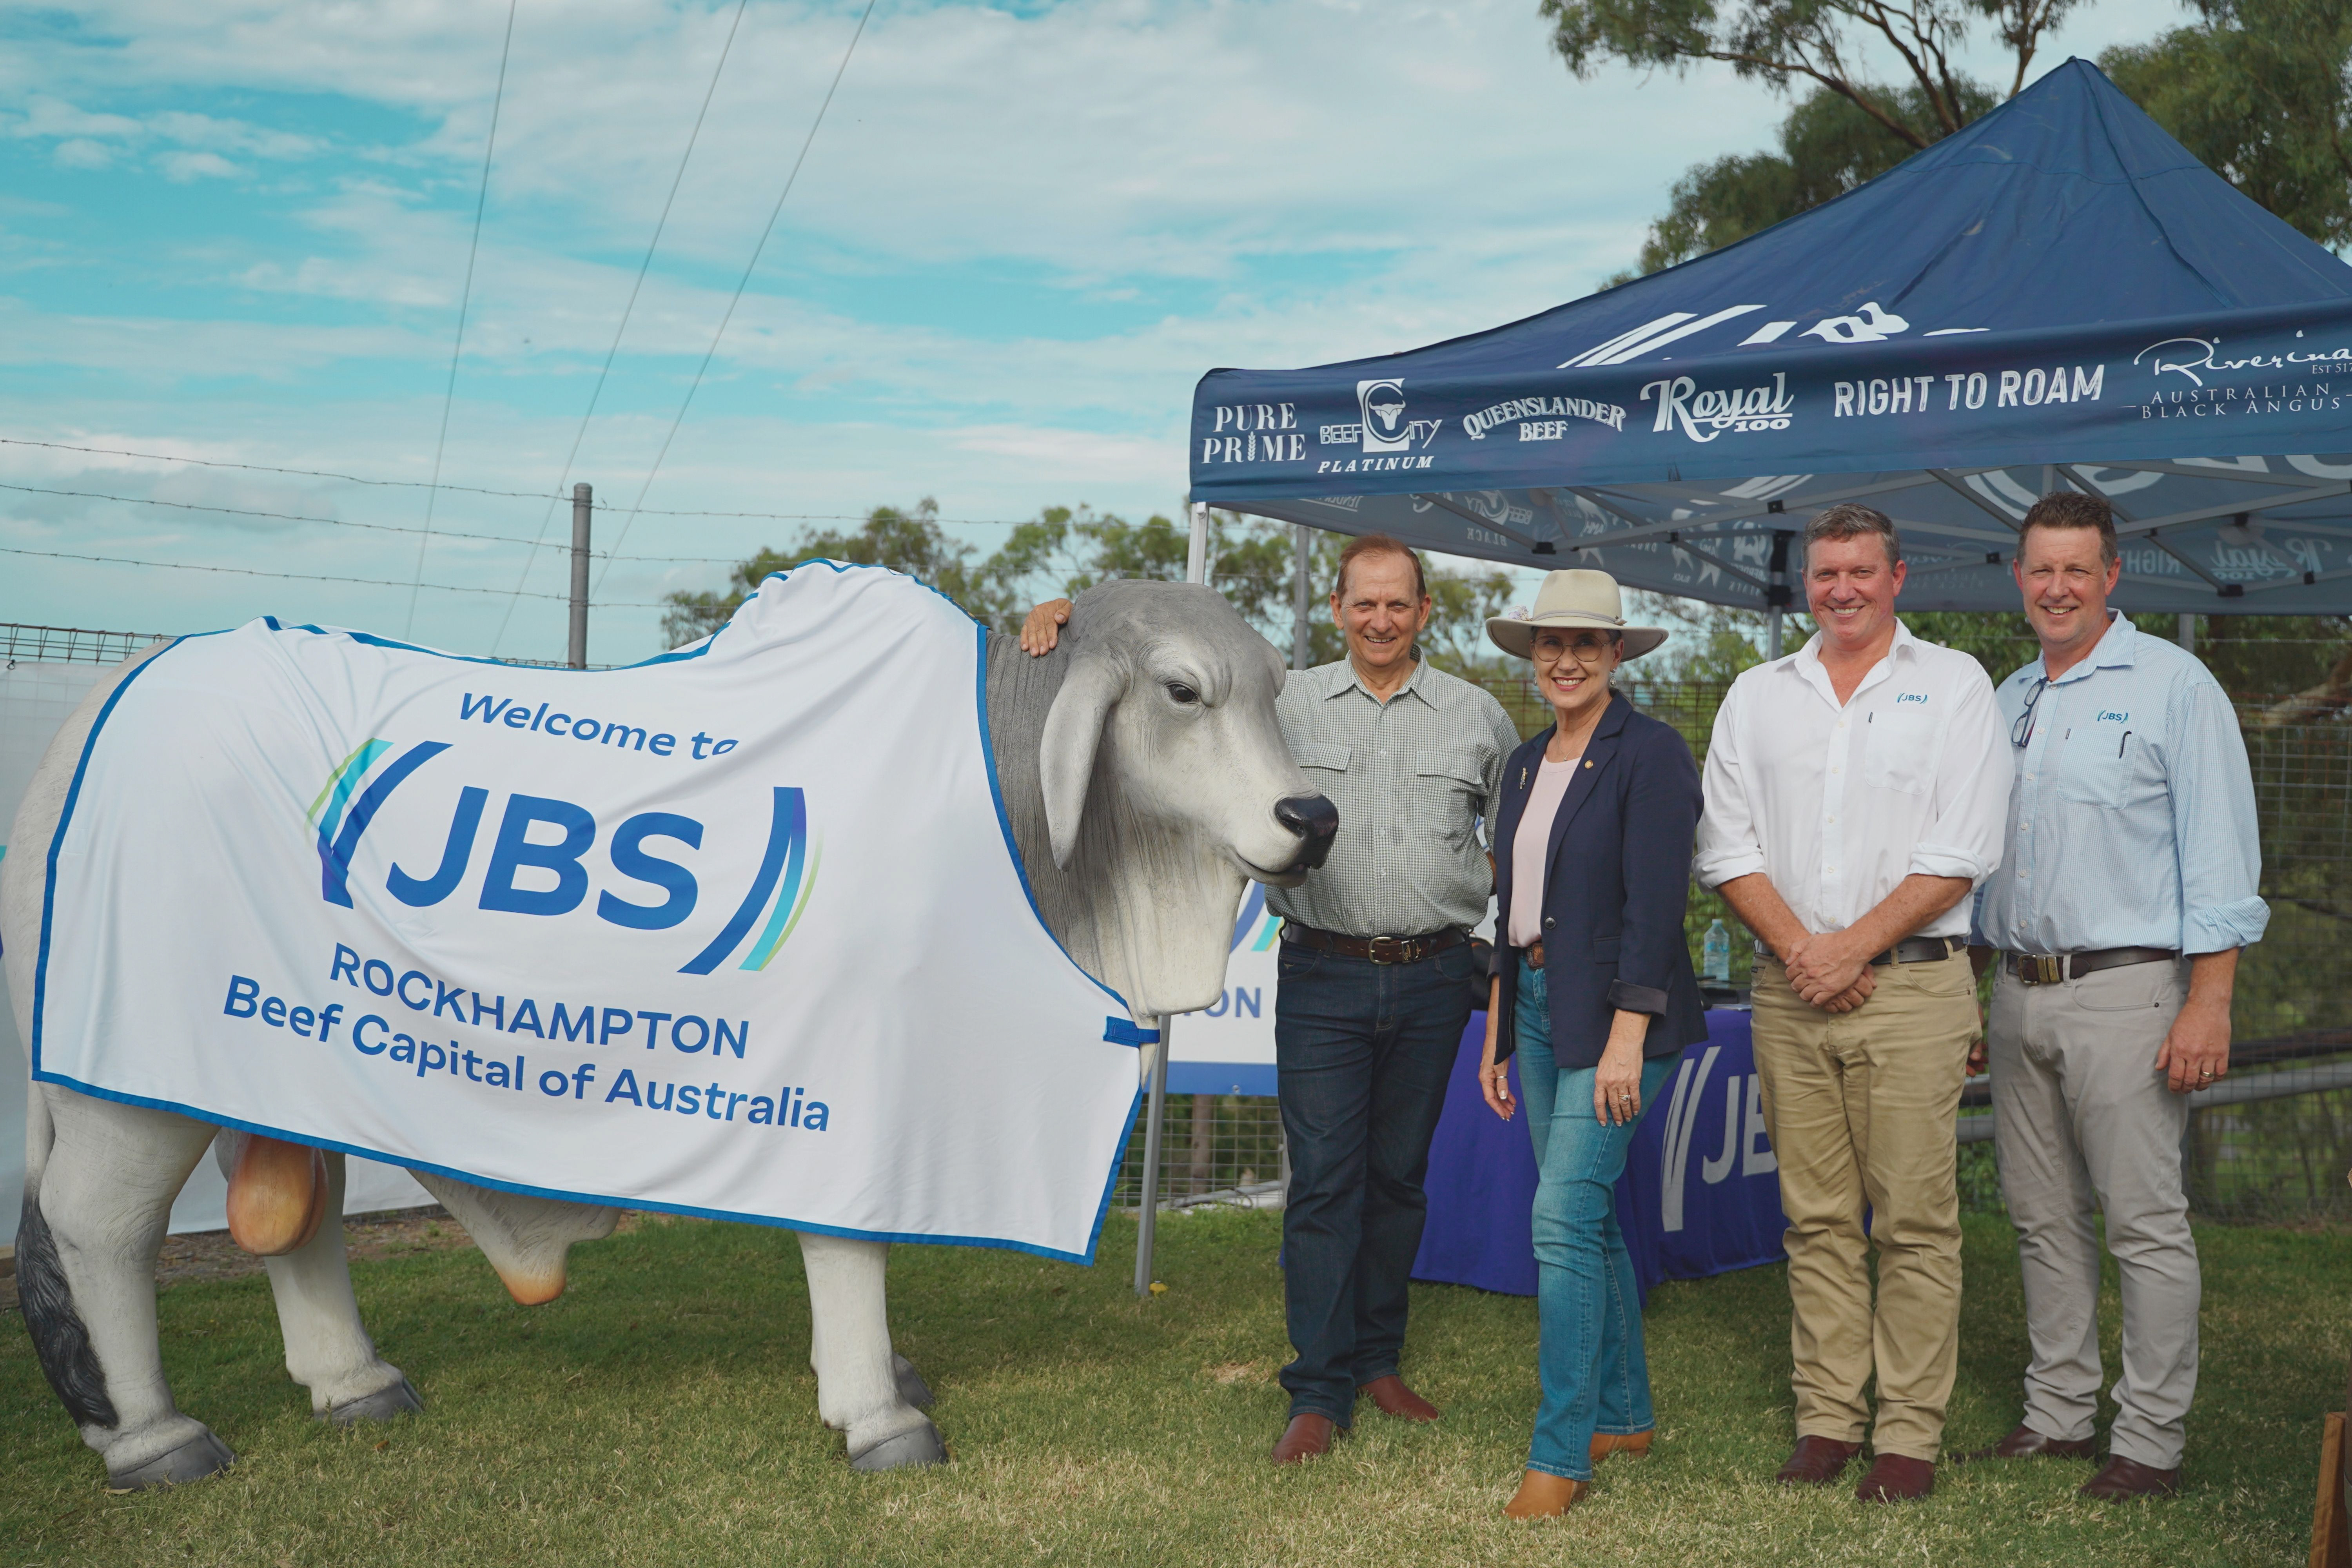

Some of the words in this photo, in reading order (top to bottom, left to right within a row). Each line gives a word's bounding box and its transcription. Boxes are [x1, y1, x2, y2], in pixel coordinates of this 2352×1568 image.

[2134, 330, 2352, 387] Riverina
[2312, 365, 2332, 374] EST
[1835, 376, 1934, 417] RIGHT
[1945, 372, 1987, 410] TO
[1998, 364, 2104, 407] ROAM
[2151, 383, 2329, 404] AUSTRALIAN
[1213, 403, 1297, 432] PURE
[1463, 397, 1626, 441] QUEENSLANDER
[1640, 372, 1794, 442] Royal
[2142, 403, 2226, 419] BLACK
[2245, 397, 2340, 414] ANGUS
[1319, 423, 1362, 444] BEEF
[1519, 420, 1568, 441] BEEF
[1734, 418, 1790, 432] 100
[1318, 456, 1434, 473] PLATINUM
[460, 693, 676, 756] Welcome
[330, 942, 750, 1059] ROCKHAMPTON
[223, 975, 344, 1042] Beef
[352, 1014, 524, 1091] Capital
[539, 1063, 595, 1100] of
[605, 1069, 830, 1131] Australia
